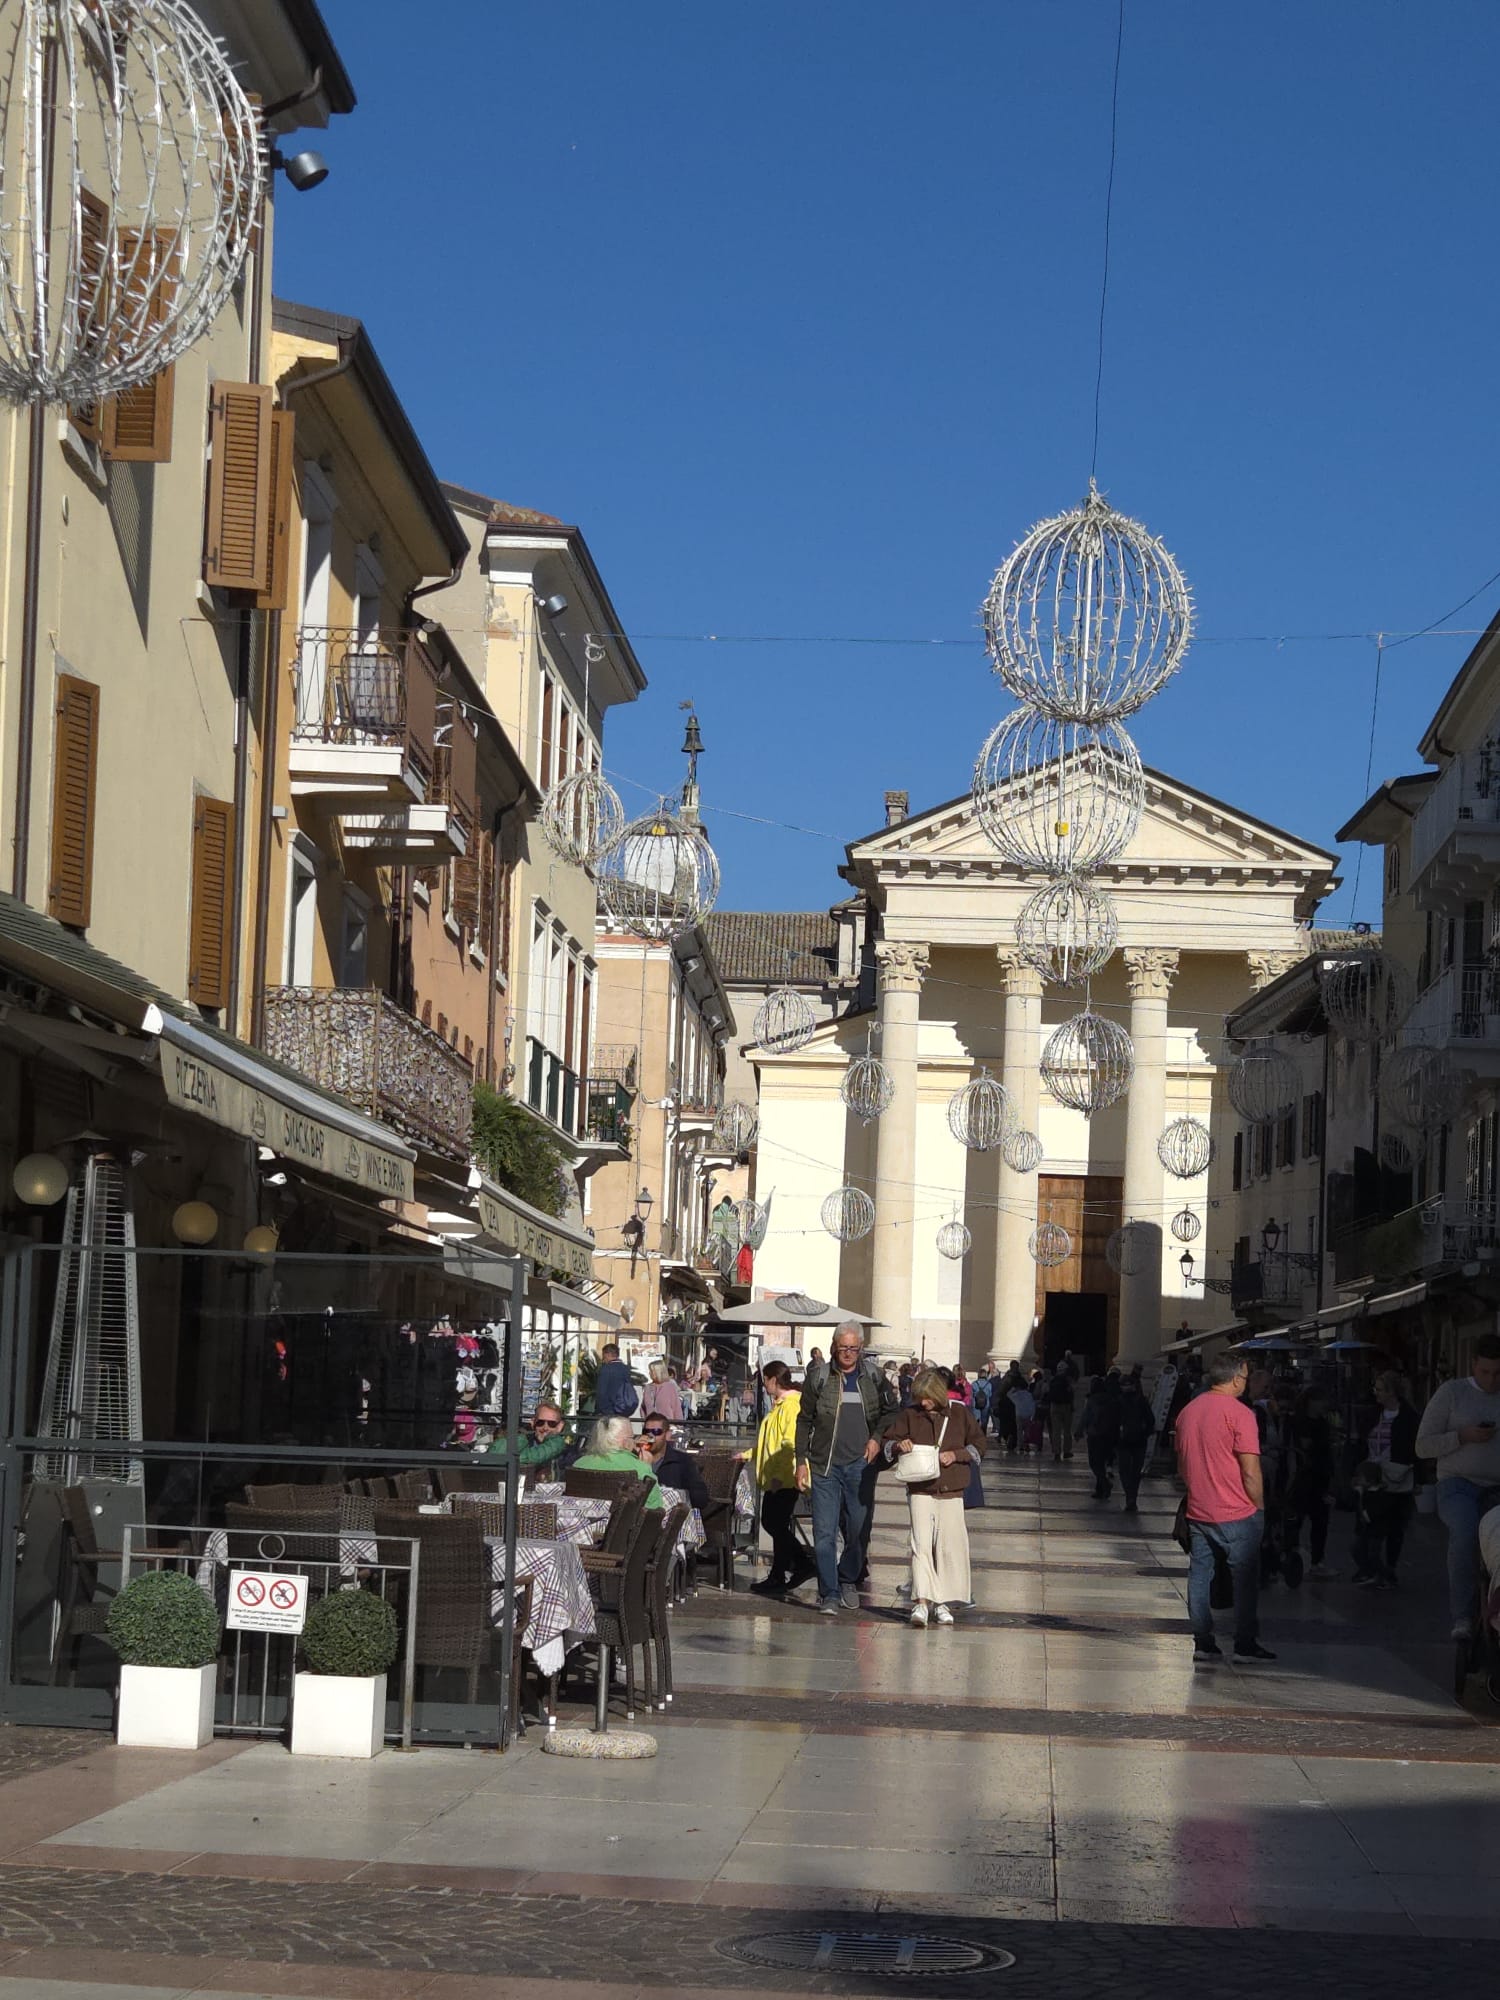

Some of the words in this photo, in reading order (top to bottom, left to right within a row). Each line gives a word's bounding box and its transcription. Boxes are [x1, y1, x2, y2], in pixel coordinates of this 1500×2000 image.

[175, 1056, 218, 1112] PIZZERIA
[284, 1112, 309, 1155] SNACK
[310, 1127, 325, 1161] BAR
